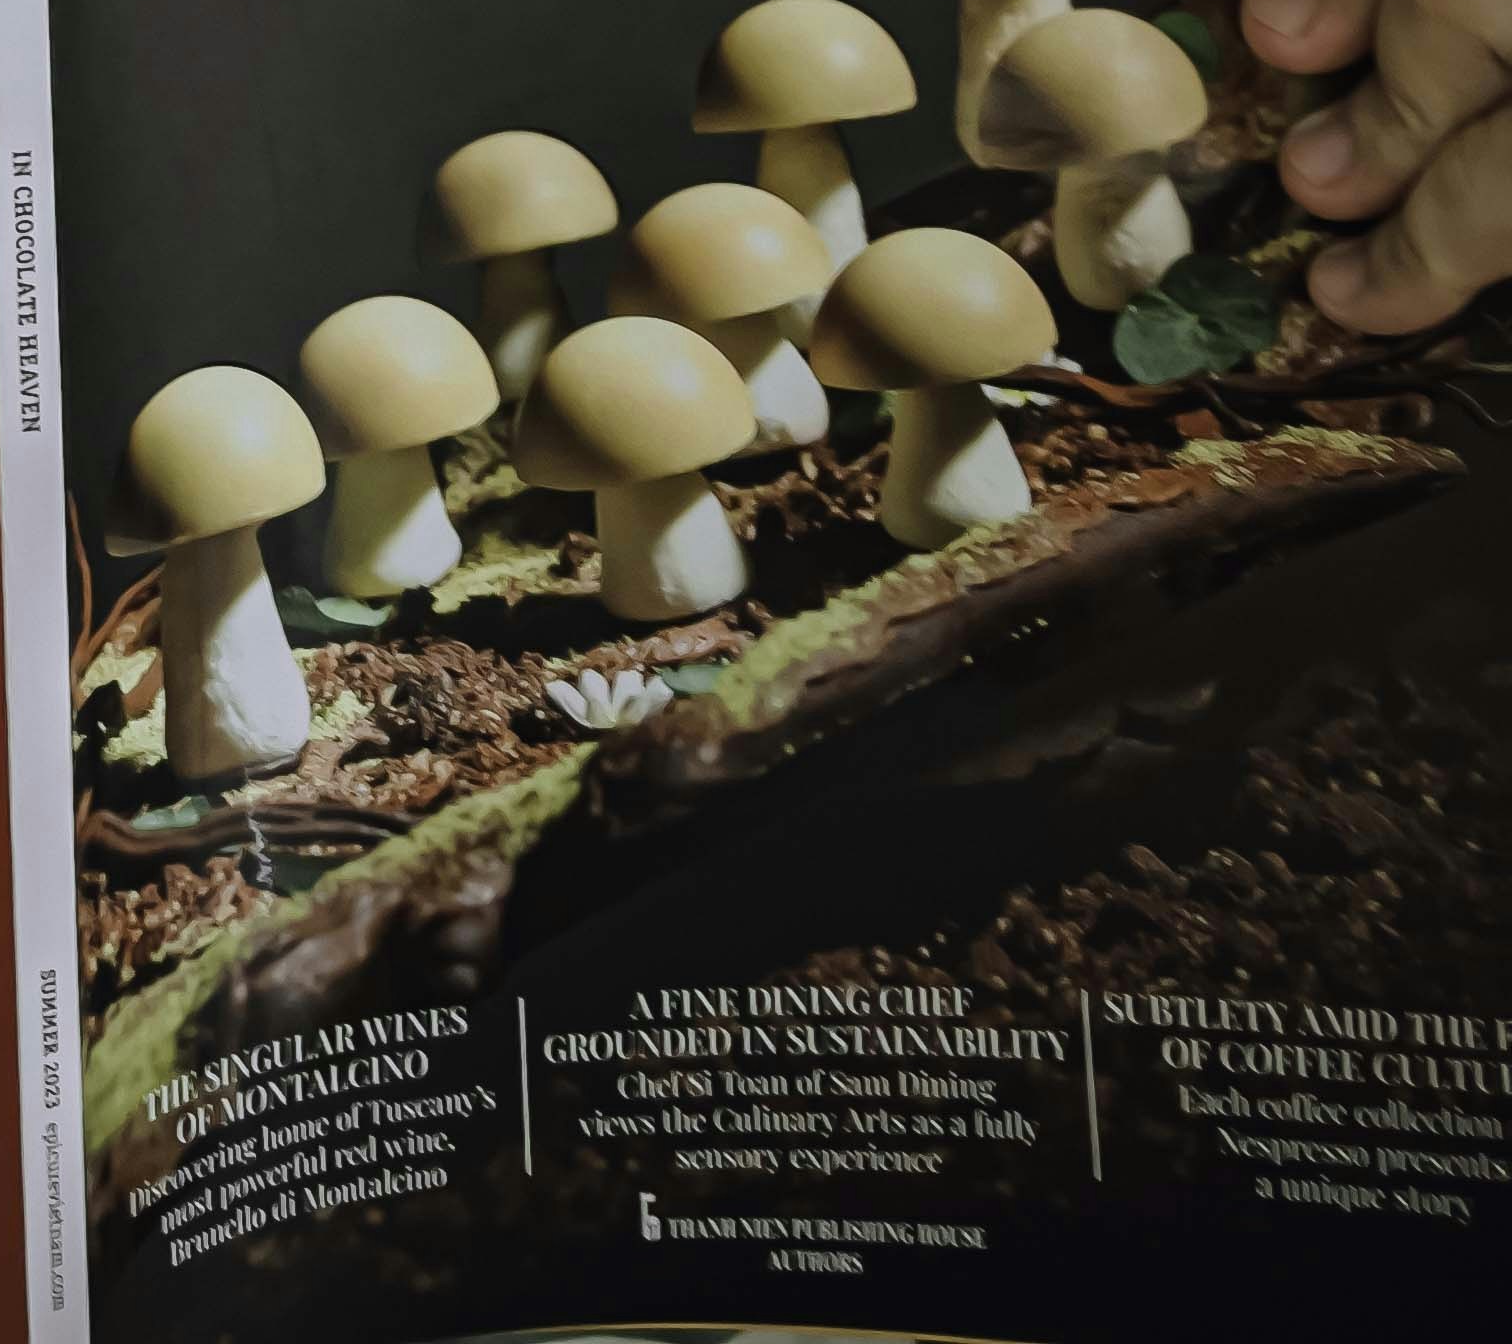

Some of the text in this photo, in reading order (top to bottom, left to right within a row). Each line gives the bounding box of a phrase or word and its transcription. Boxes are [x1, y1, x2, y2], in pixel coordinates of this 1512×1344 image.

[12, 150, 42, 432] IN CHOCOLATE HEAVEN
[40, 969, 58, 1057] SUMMER
[628, 984, 974, 1021] A FINE DINING CHEF
[1102, 990, 1288, 1034] SUBTLETY
[1297, 1002, 1399, 1041] AMID
[1404, 1011, 1485, 1050] THE
[141, 1005, 468, 1122] THE SINGULAR WINES
[543, 1025, 1069, 1065] GROUNDED IN SUSTAINABILITY
[1161, 1036, 1211, 1071] OF
[1217, 1040, 1368, 1083] COFFEE
[42, 1062, 61, 1110] 2023
[176, 1049, 429, 1144] OF MONTALCINO
[616, 1072, 685, 1101] Chef
[796, 1068, 824, 1097] of
[899, 1070, 997, 1105] Dining
[1177, 1084, 1252, 1118] Each
[1257, 1092, 1348, 1126] coffee
[262, 1116, 329, 1152] home
[335, 1102, 364, 1132] of
[580, 1104, 1040, 1147] views the Culinary Arts as a fully
[160, 1187, 212, 1235] most
[219, 1146, 327, 1211] powerful
[334, 1134, 377, 1169] red
[675, 1144, 944, 1175] sensory experience
[170, 1164, 448, 1267] Brunello di Montalcino
[1254, 1173, 1473, 1225] a unique story
